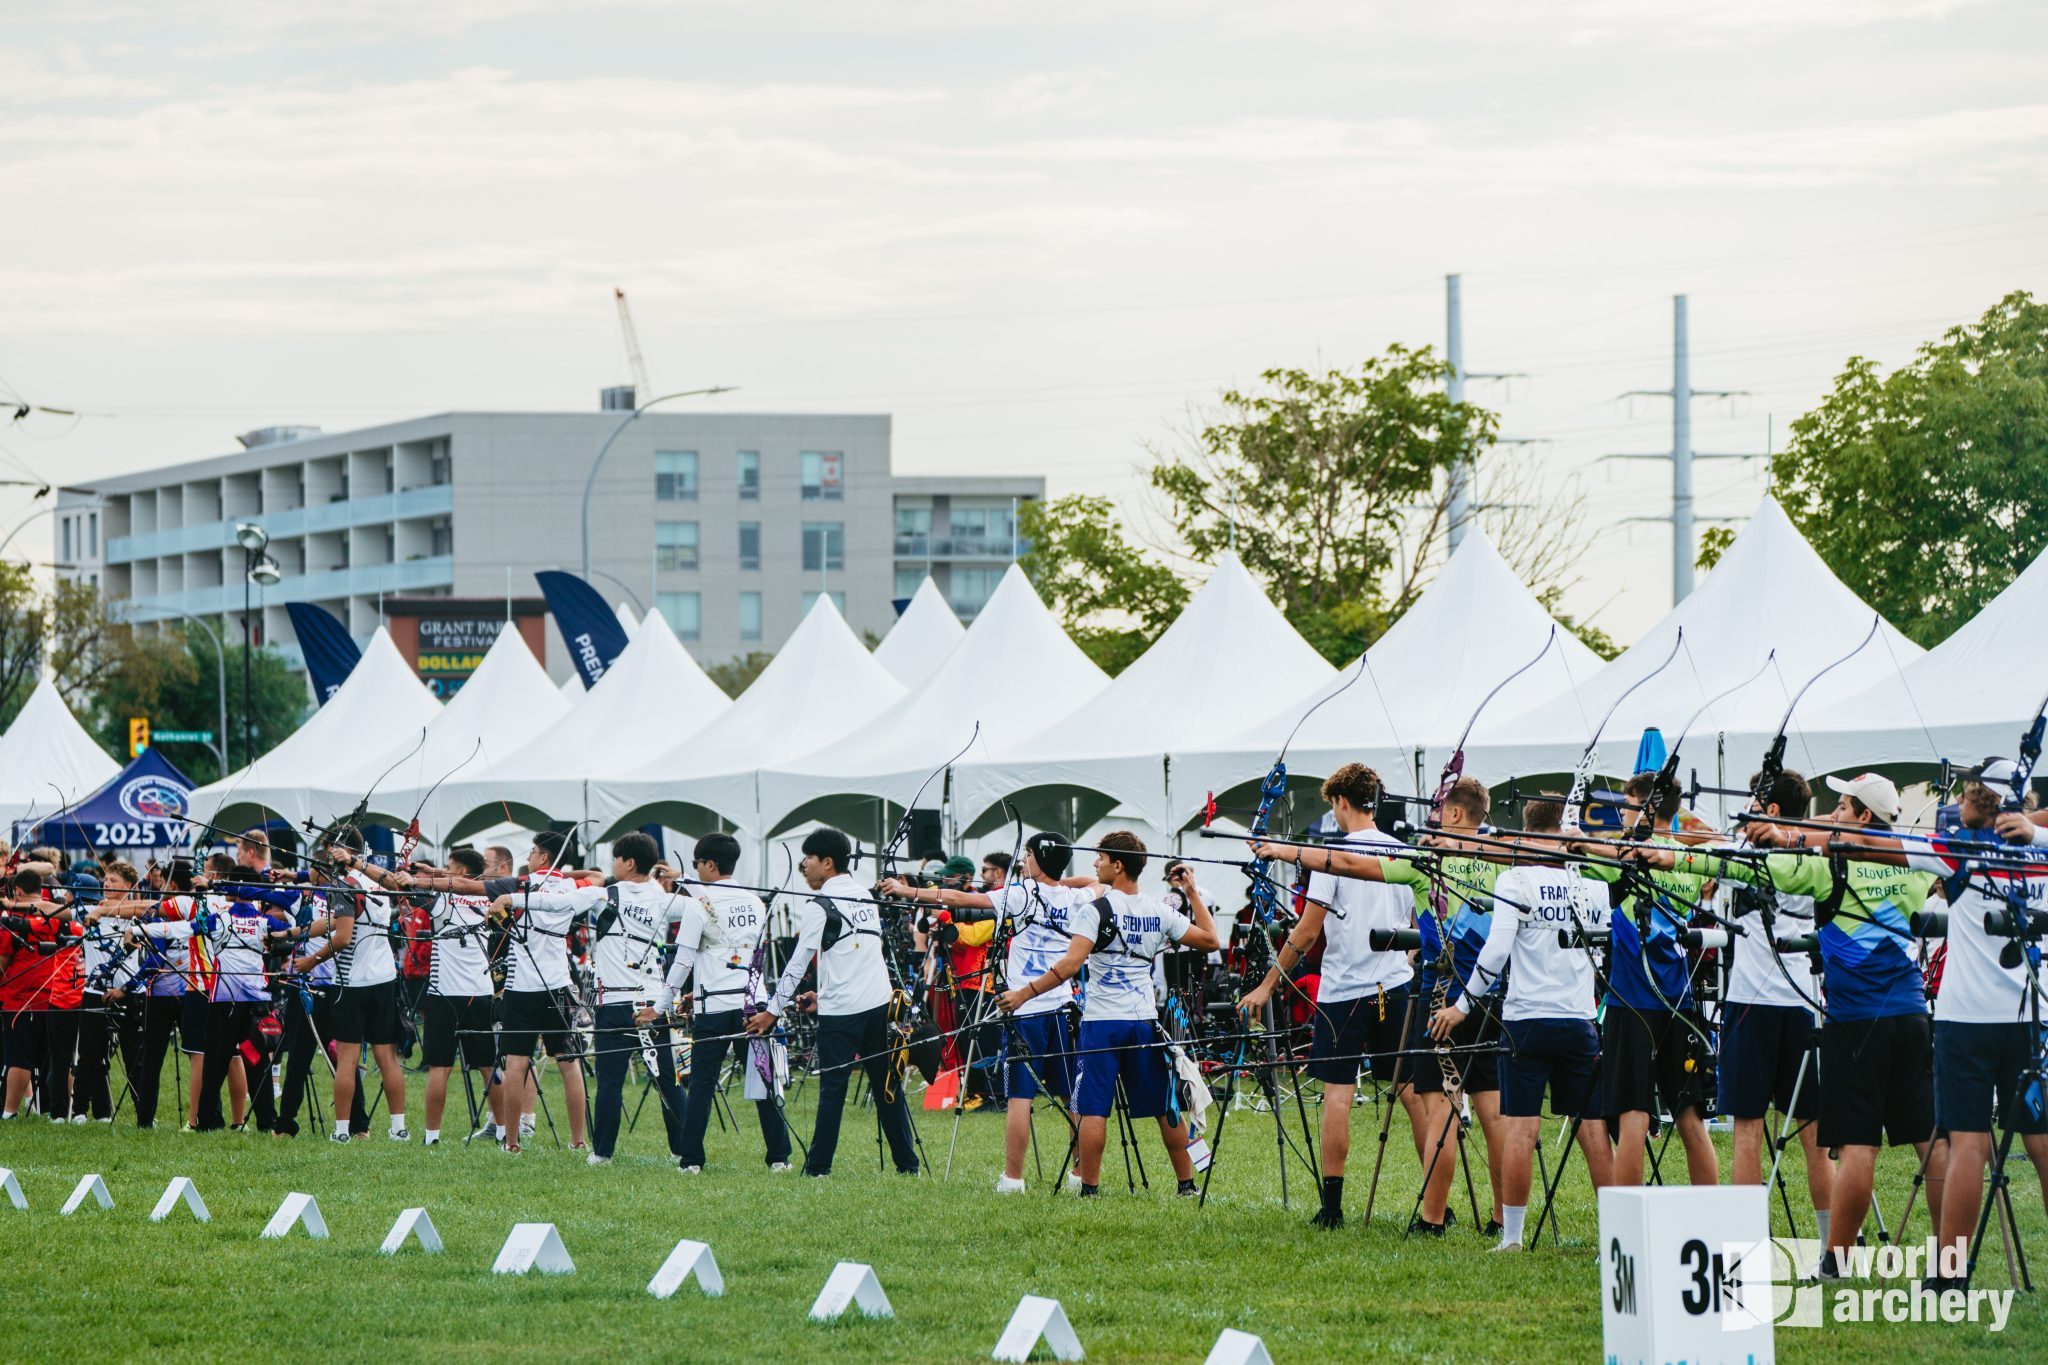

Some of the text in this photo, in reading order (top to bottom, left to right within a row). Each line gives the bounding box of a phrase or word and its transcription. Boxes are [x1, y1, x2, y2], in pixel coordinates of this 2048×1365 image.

[420, 620, 474, 636] GRANT
[95, 823, 156, 846] 2025
[1866, 883, 1908, 897] VRBEC
[728, 914, 757, 929] KOR
[852, 909, 876, 925] KOR
[1611, 1237, 1637, 1316] 3M
